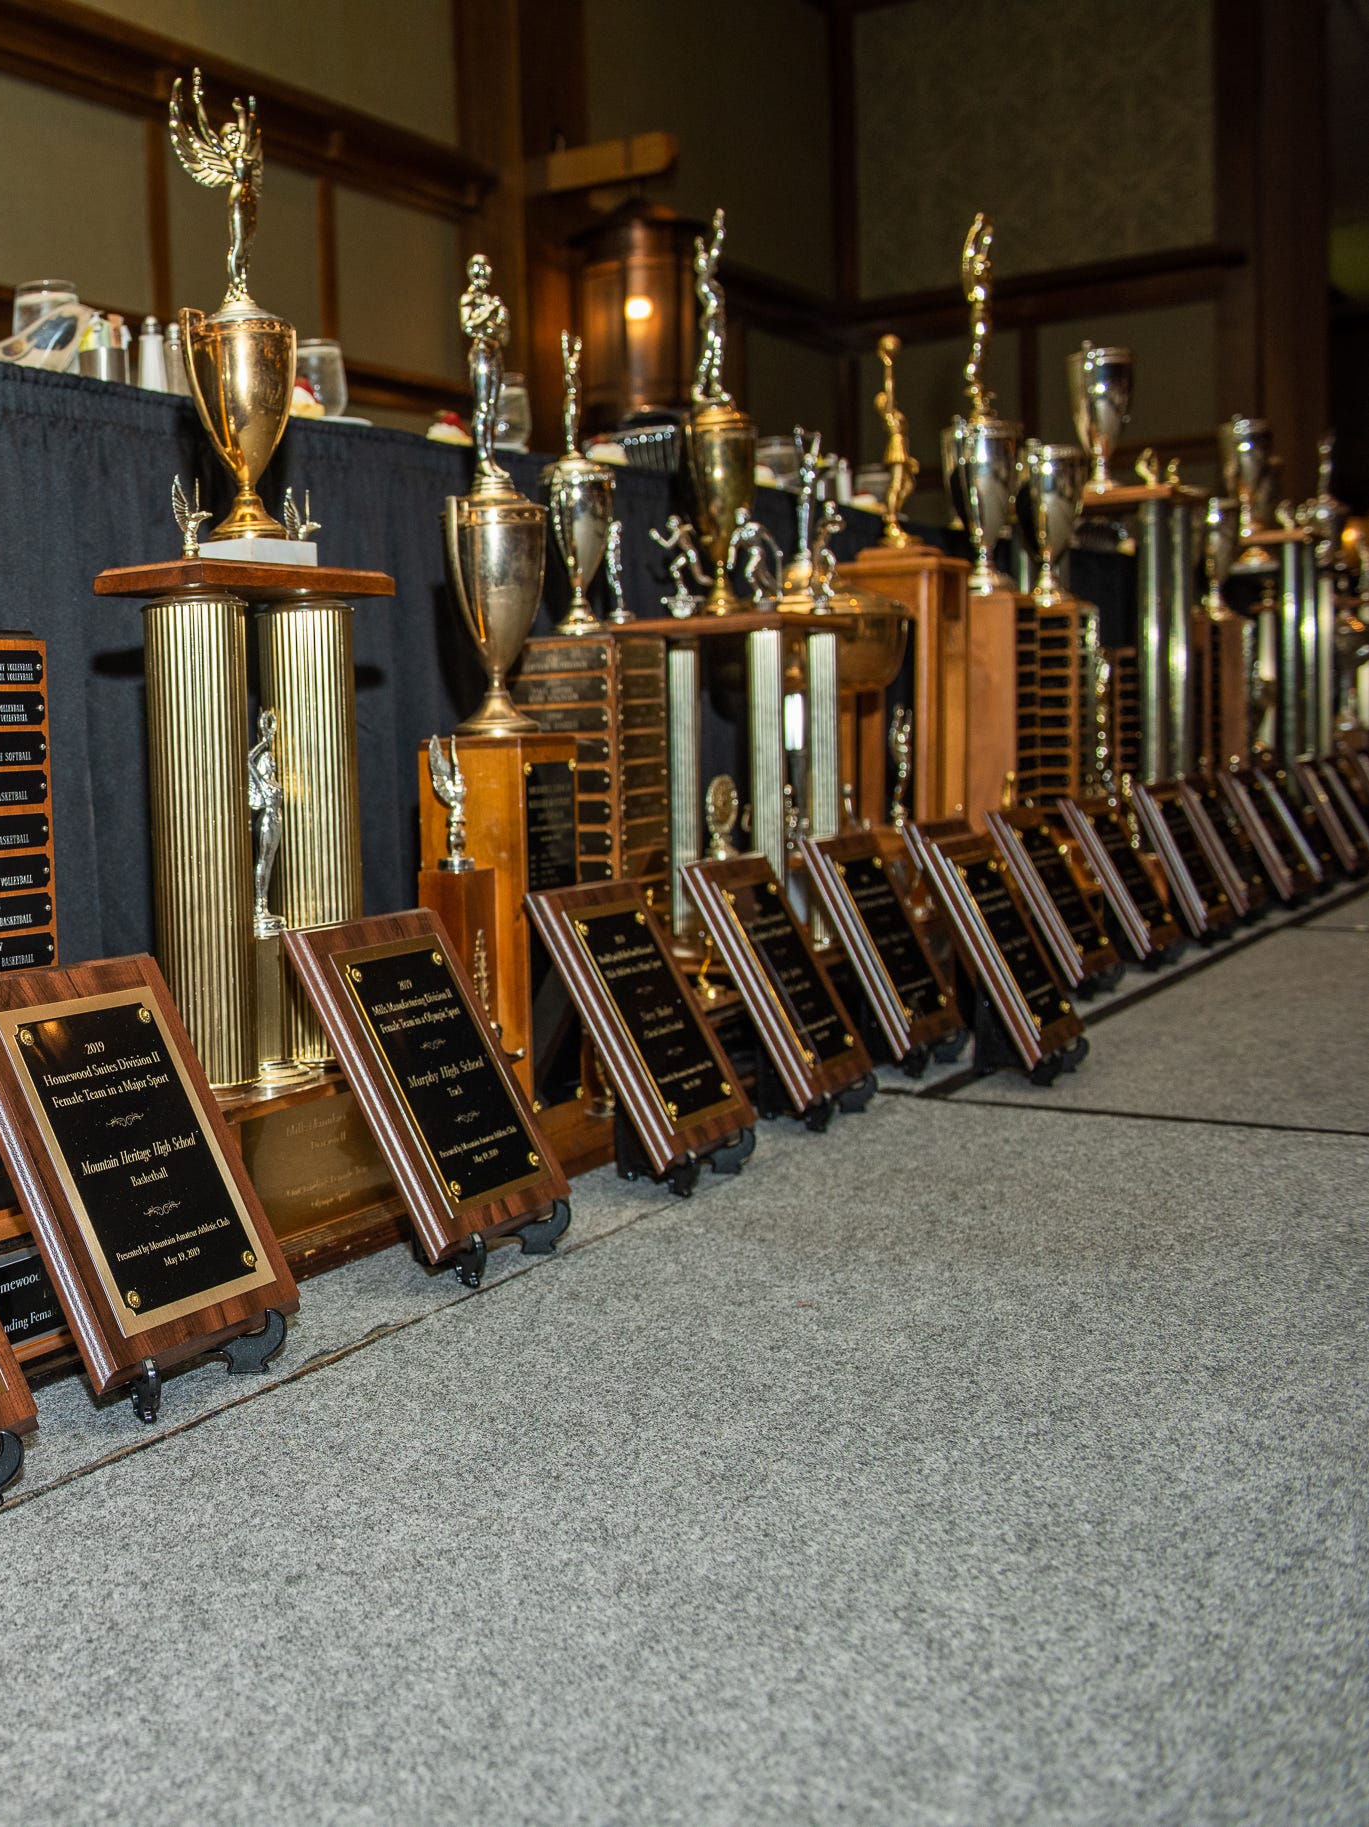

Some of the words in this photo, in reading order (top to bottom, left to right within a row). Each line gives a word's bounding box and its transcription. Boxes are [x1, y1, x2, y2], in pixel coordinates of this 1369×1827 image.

[5, 752, 32, 761] SOFTBALL
[1, 874, 33, 887] VOLLEYBALL
[84, 1041, 105, 1055] 2019
[43, 1066, 94, 1087] Homewood
[93, 1062, 119, 1076] Suites
[117, 1055, 152, 1070] Division
[150, 1051, 161, 1063] II
[407, 1068, 439, 1088] Murphy
[441, 1062, 460, 1079] High
[460, 1056, 485, 1073] School
[52, 1092, 84, 1108] Female
[83, 1086, 107, 1101] Team
[107, 1084, 117, 1095] in
[118, 1085, 124, 1094] a
[122, 1078, 147, 1092] Major
[146, 1073, 169, 1088] Sport
[81, 1154, 120, 1176] Mountain
[120, 1147, 152, 1163] Heritage
[152, 1138, 172, 1157] High
[172, 1131, 196, 1149] School
[130, 1167, 168, 1187] Basketball
[116, 1246, 143, 1262] Presented
[142, 1245, 151, 1255] by
[148, 1235, 176, 1251] Mountain
[175, 1229, 198, 1243] Amateur
[197, 1222, 217, 1236] Athletic
[216, 1217, 230, 1230] Club
[163, 1255, 179, 1267] May
[178, 1251, 188, 1261] 19,
[187, 1247, 200, 1259] 2019
[30, 1306, 57, 1324] Fema
